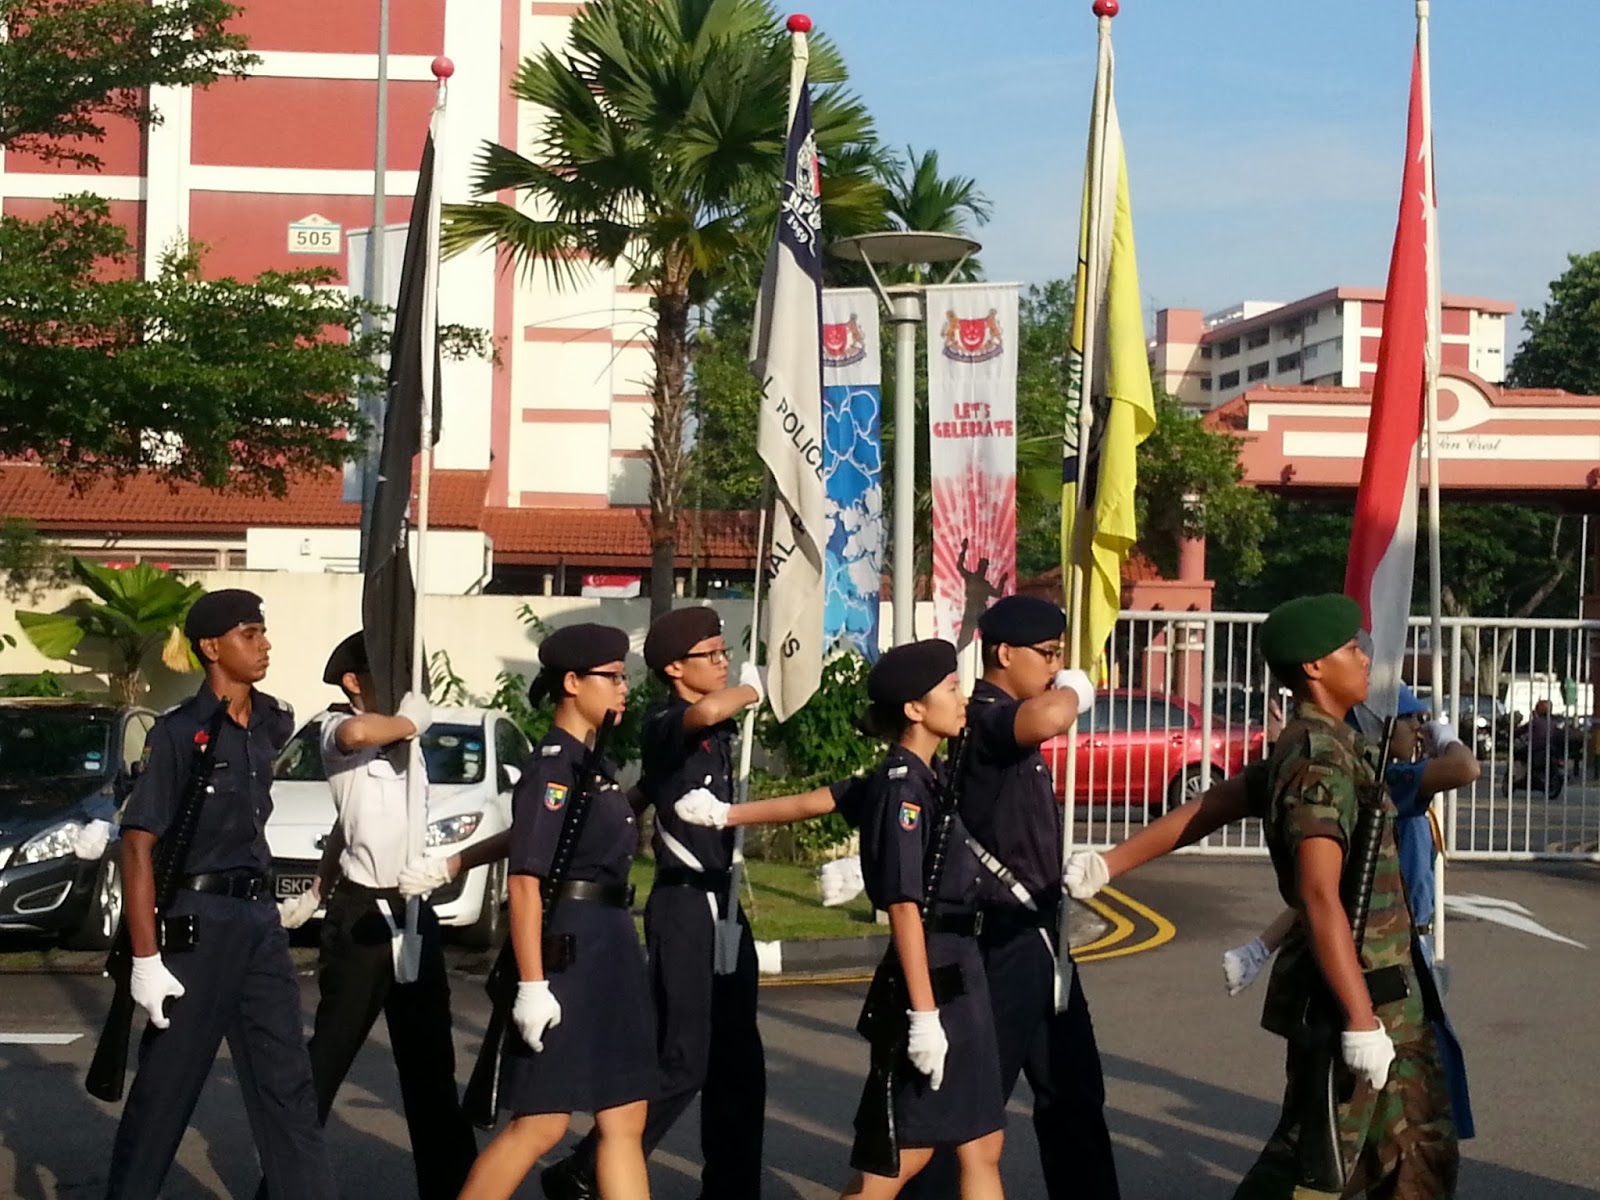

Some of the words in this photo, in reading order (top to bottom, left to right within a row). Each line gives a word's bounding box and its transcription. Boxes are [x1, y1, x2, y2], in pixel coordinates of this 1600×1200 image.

[297, 231, 332, 246] 505
[953, 402, 991, 420] LET'S
[933, 420, 1014, 438] CELEBRATE
[1466, 436, 1502, 451] Crest
